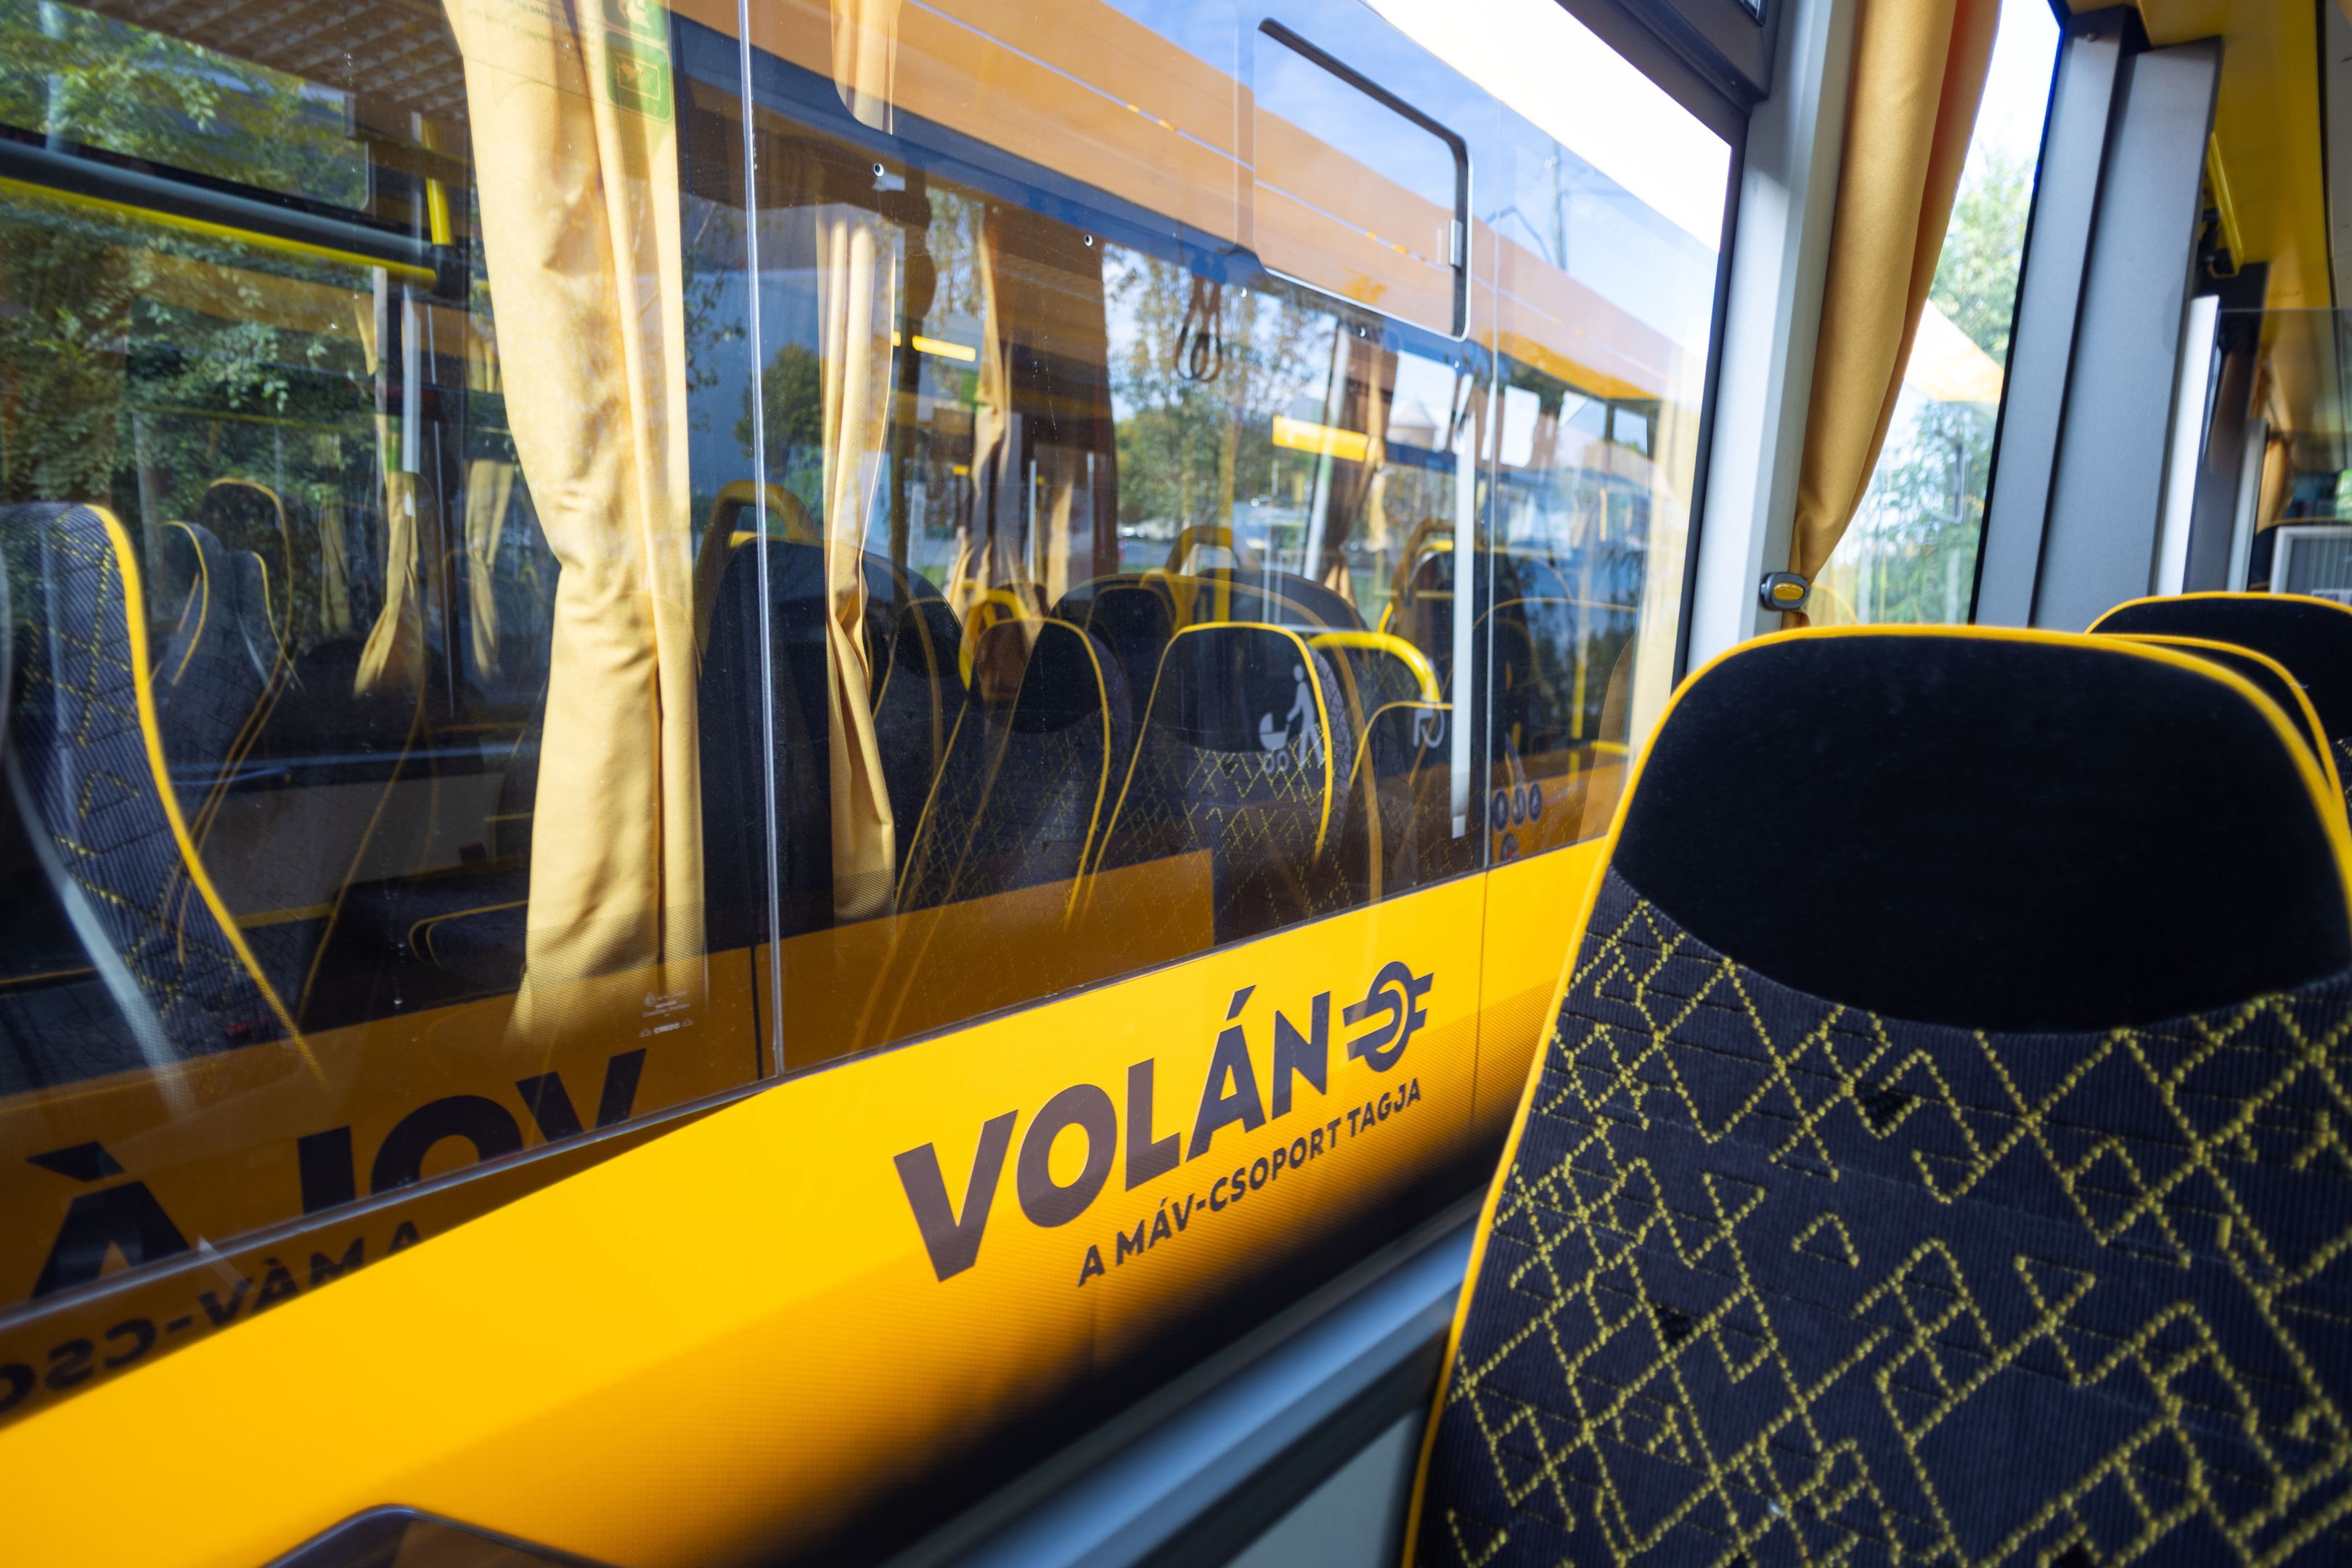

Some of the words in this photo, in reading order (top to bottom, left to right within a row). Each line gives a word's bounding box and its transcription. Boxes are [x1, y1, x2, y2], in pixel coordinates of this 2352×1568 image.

[894, 985, 1331, 1283] VOLÁN
[1077, 1244, 1105, 1289] A
[1116, 1116, 1342, 1267] MÁV-CSOPORT
[1347, 1077, 1421, 1138] TAGJA
